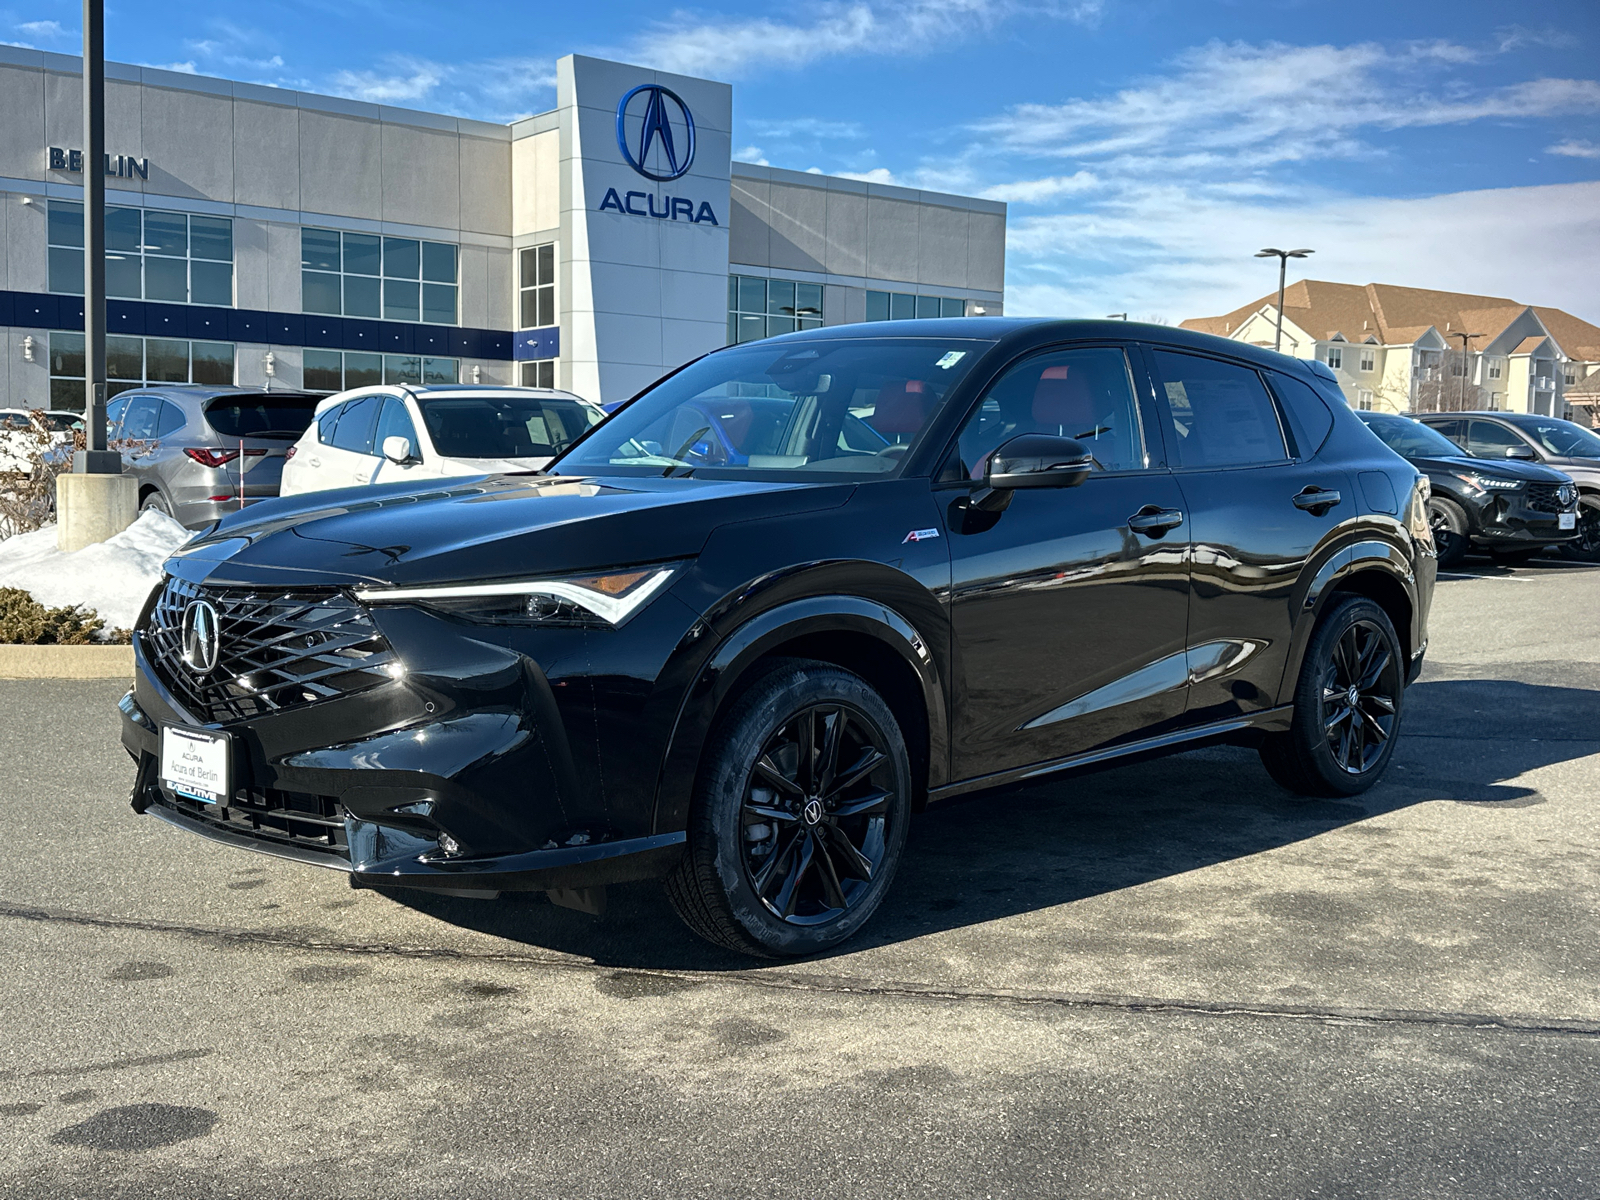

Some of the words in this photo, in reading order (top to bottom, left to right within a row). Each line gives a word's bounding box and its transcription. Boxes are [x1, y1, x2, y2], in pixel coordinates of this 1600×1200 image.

[47, 146, 149, 180] BELIN
[599, 187, 719, 226] ACURA
[182, 752, 203, 763] ACURA
[171, 760, 188, 775] Acura
[188, 766, 196, 778] of
[197, 766, 218, 781] Berlin
[166, 780, 217, 801] EXECUTIVE
